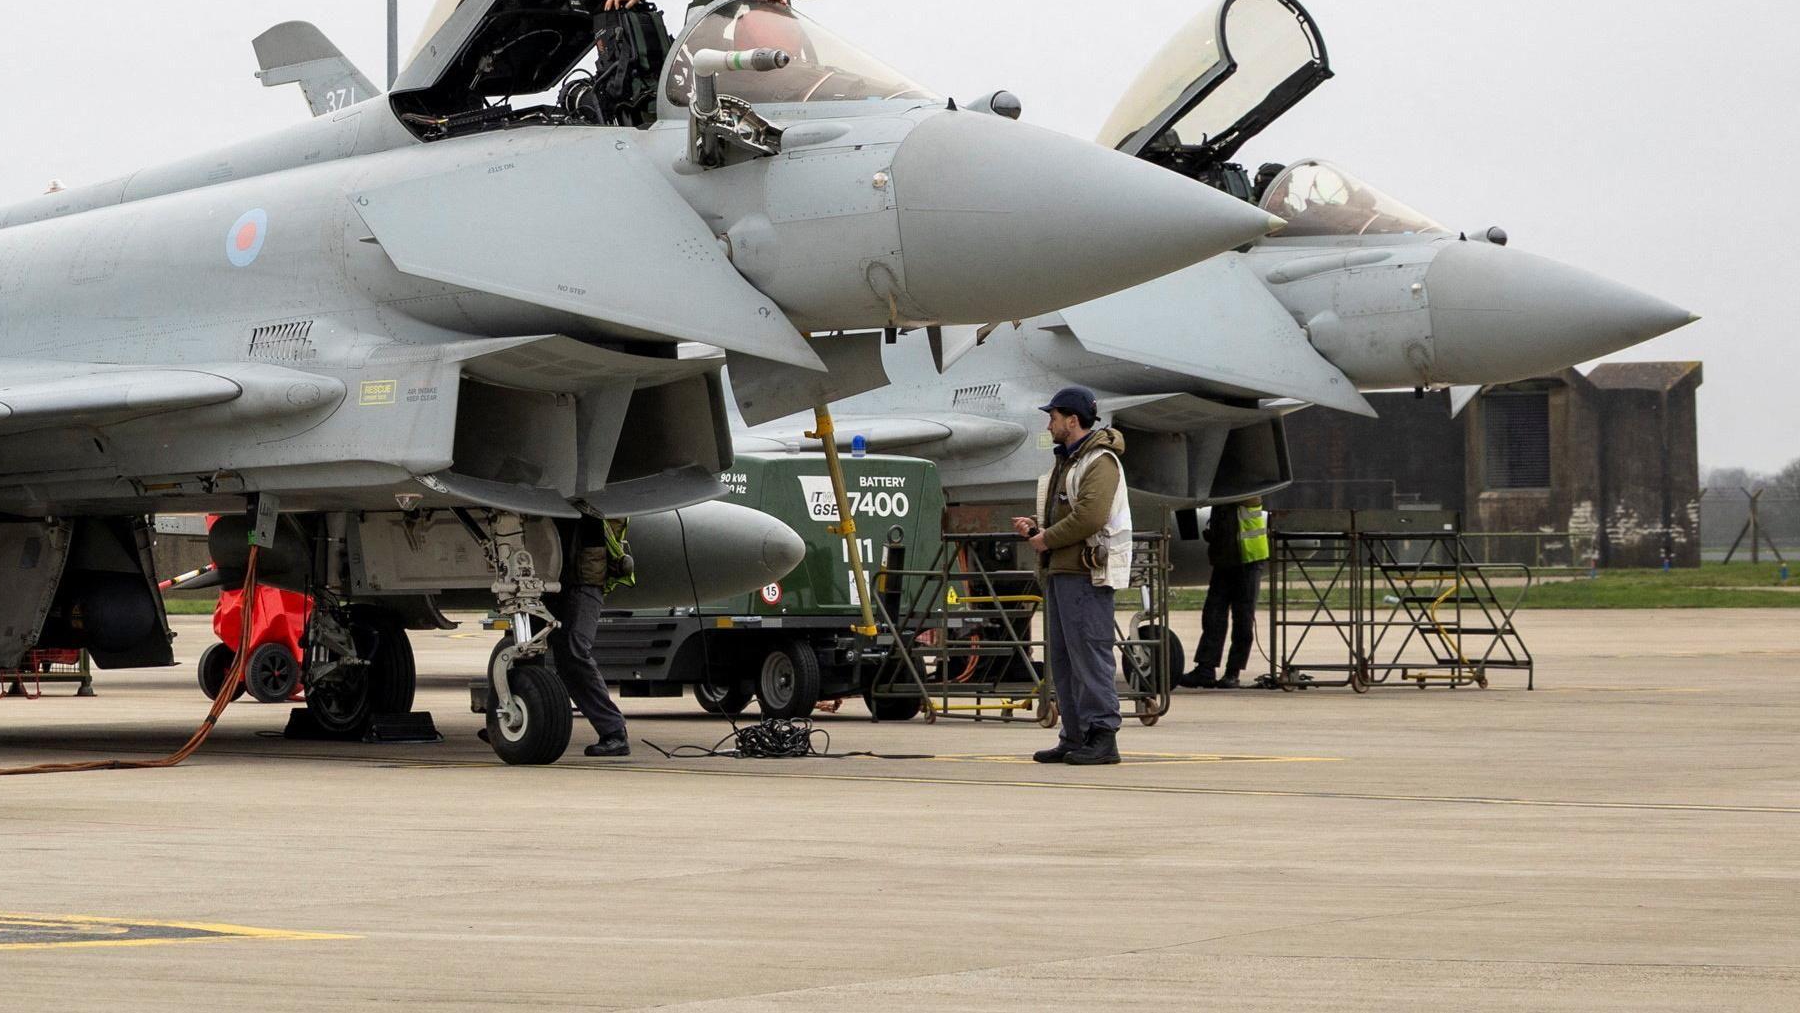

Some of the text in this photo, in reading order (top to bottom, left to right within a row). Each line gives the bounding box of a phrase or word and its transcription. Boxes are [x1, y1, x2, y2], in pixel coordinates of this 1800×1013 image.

[558, 284, 586, 296] NO STEP
[418, 387, 438, 395] INTAKE
[720, 473, 747, 483] 90 kVA
[859, 476, 906, 487] BATTERY
[736, 485, 747, 494] Hz
[813, 504, 838, 516] GSE
[847, 491, 909, 518] 7400
[766, 586, 777, 597] 15
